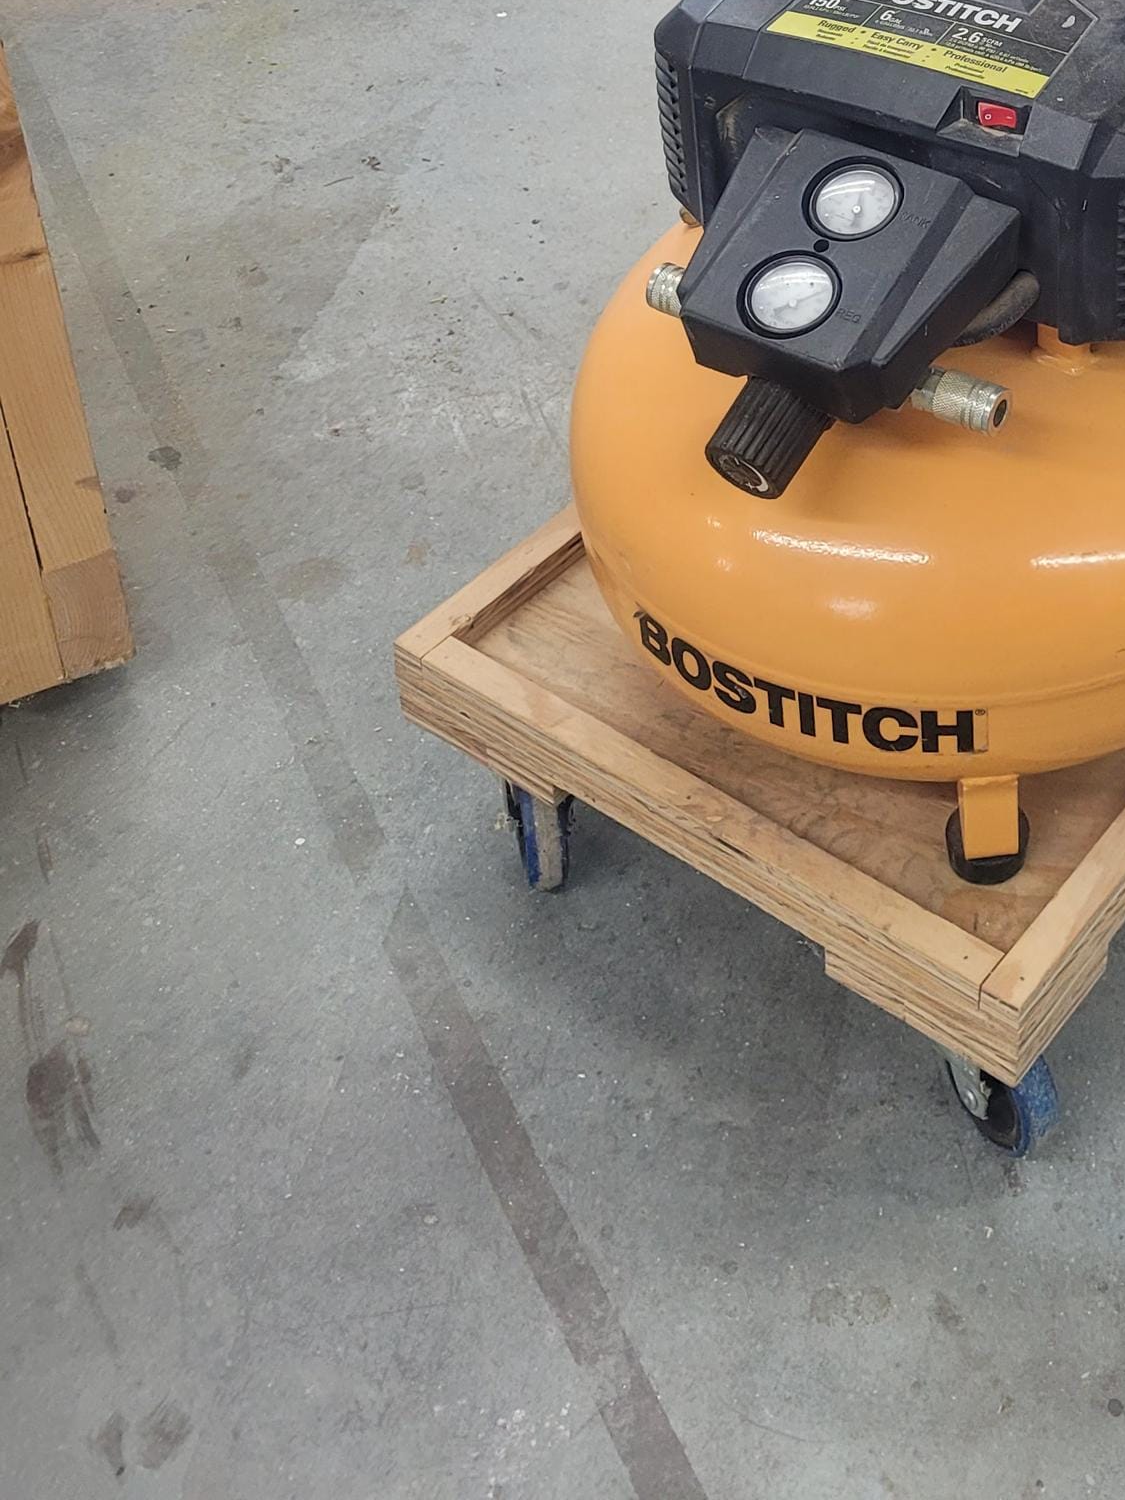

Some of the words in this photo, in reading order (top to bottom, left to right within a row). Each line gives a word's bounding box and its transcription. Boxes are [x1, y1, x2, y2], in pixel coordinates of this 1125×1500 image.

[817, 19, 857, 35] Rugged
[951, 27, 982, 44] 2.6
[870, 31, 897, 46] Easy
[893, 36, 924, 51] Carry
[943, 49, 1009, 74] Professional
[637, 611, 974, 753] BOSTITCH
